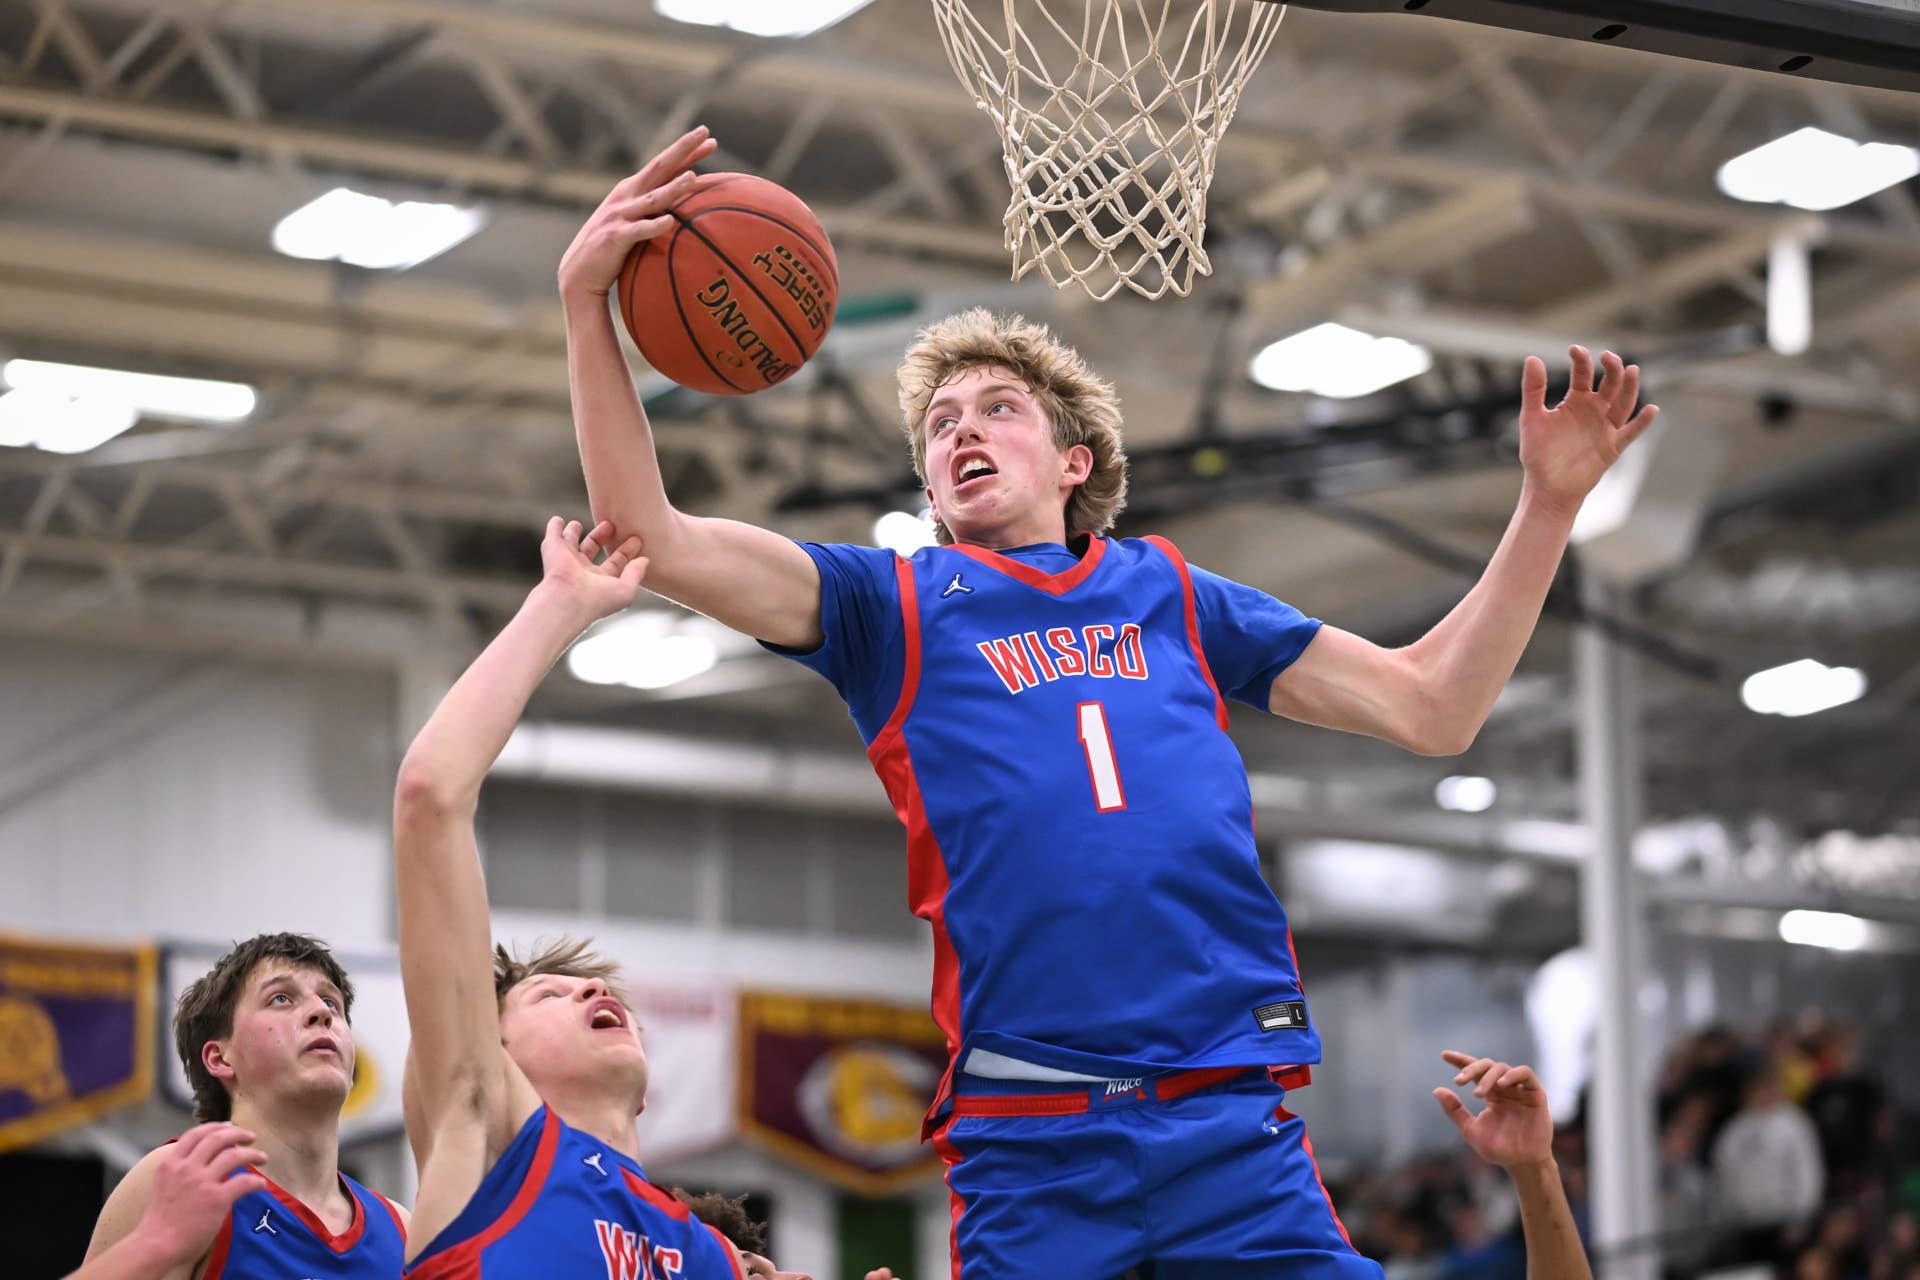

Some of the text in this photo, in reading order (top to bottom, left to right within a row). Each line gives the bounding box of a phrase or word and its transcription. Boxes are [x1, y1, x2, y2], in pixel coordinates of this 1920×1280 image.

[753, 252, 827, 342] LEGACY
[976, 623, 1149, 695] WISCO
[1076, 701, 1127, 813] 1
[594, 1219, 683, 1280] WIS
